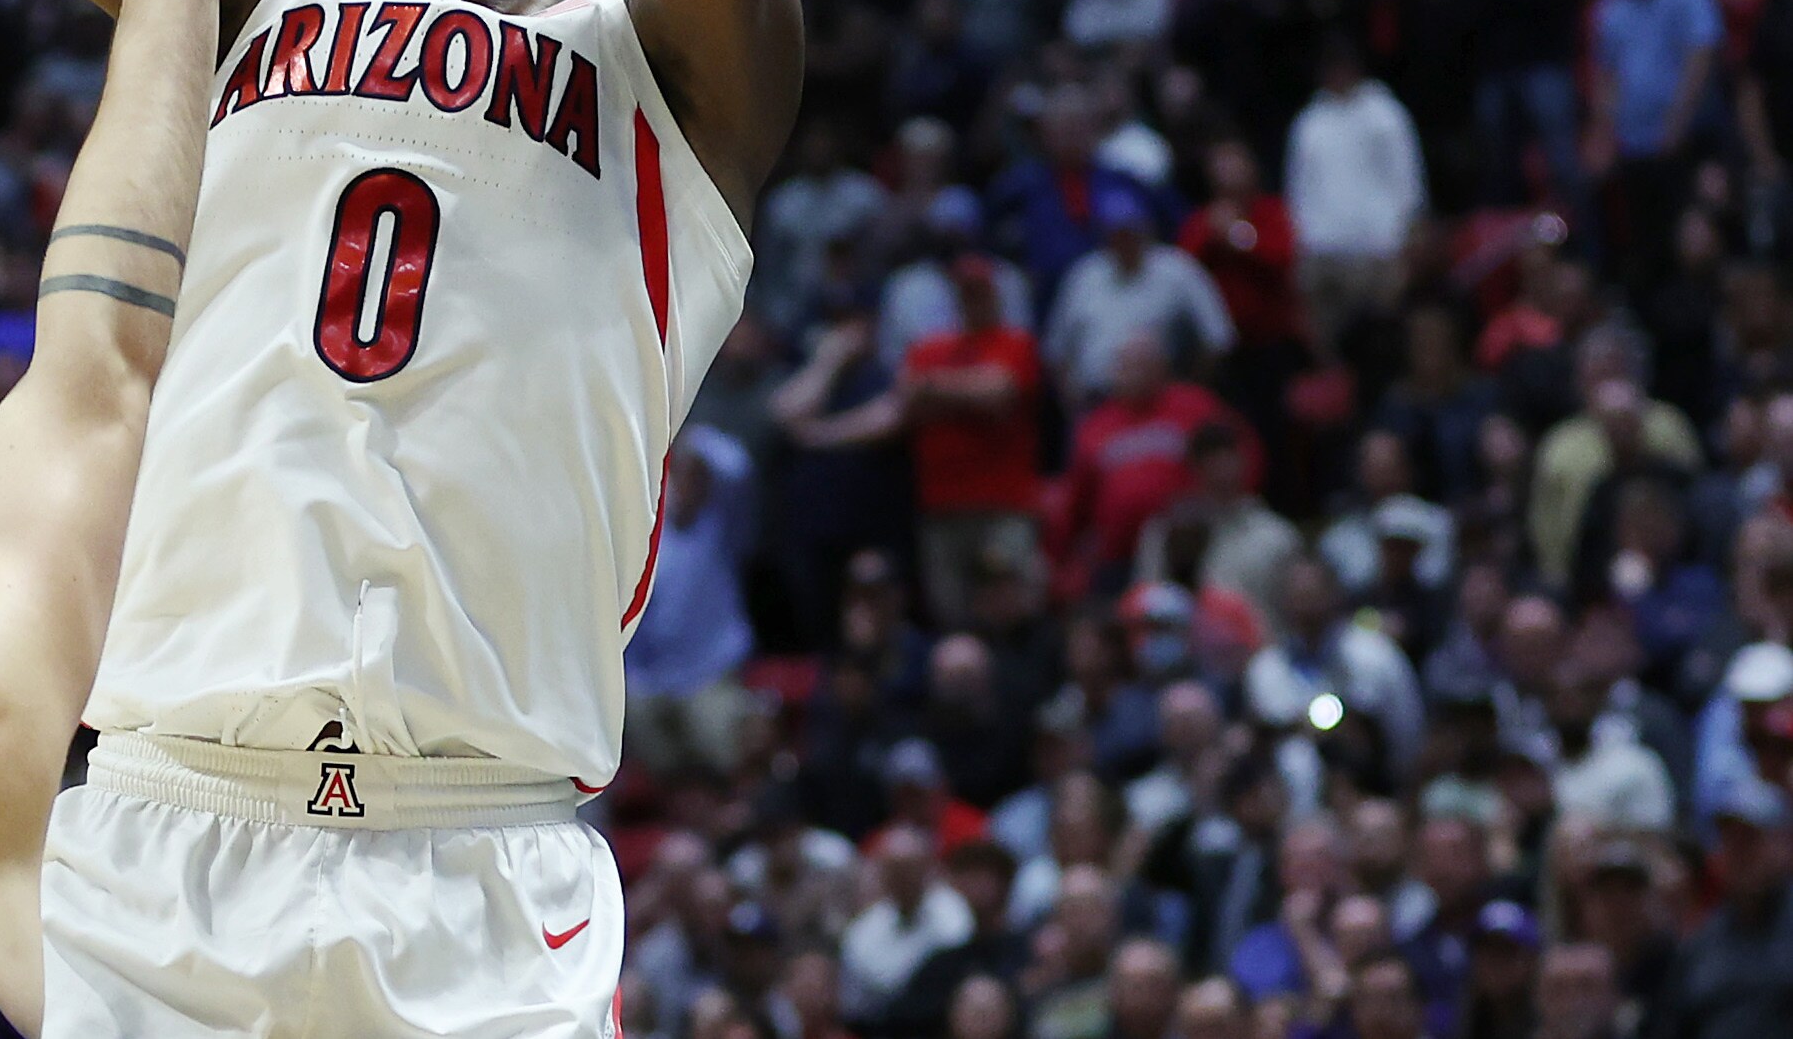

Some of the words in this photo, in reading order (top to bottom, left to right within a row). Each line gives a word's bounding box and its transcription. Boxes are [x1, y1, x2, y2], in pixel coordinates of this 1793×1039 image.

[209, 2, 601, 181] ARIZONA
[313, 167, 441, 384] 0
[306, 763, 365, 817] A
